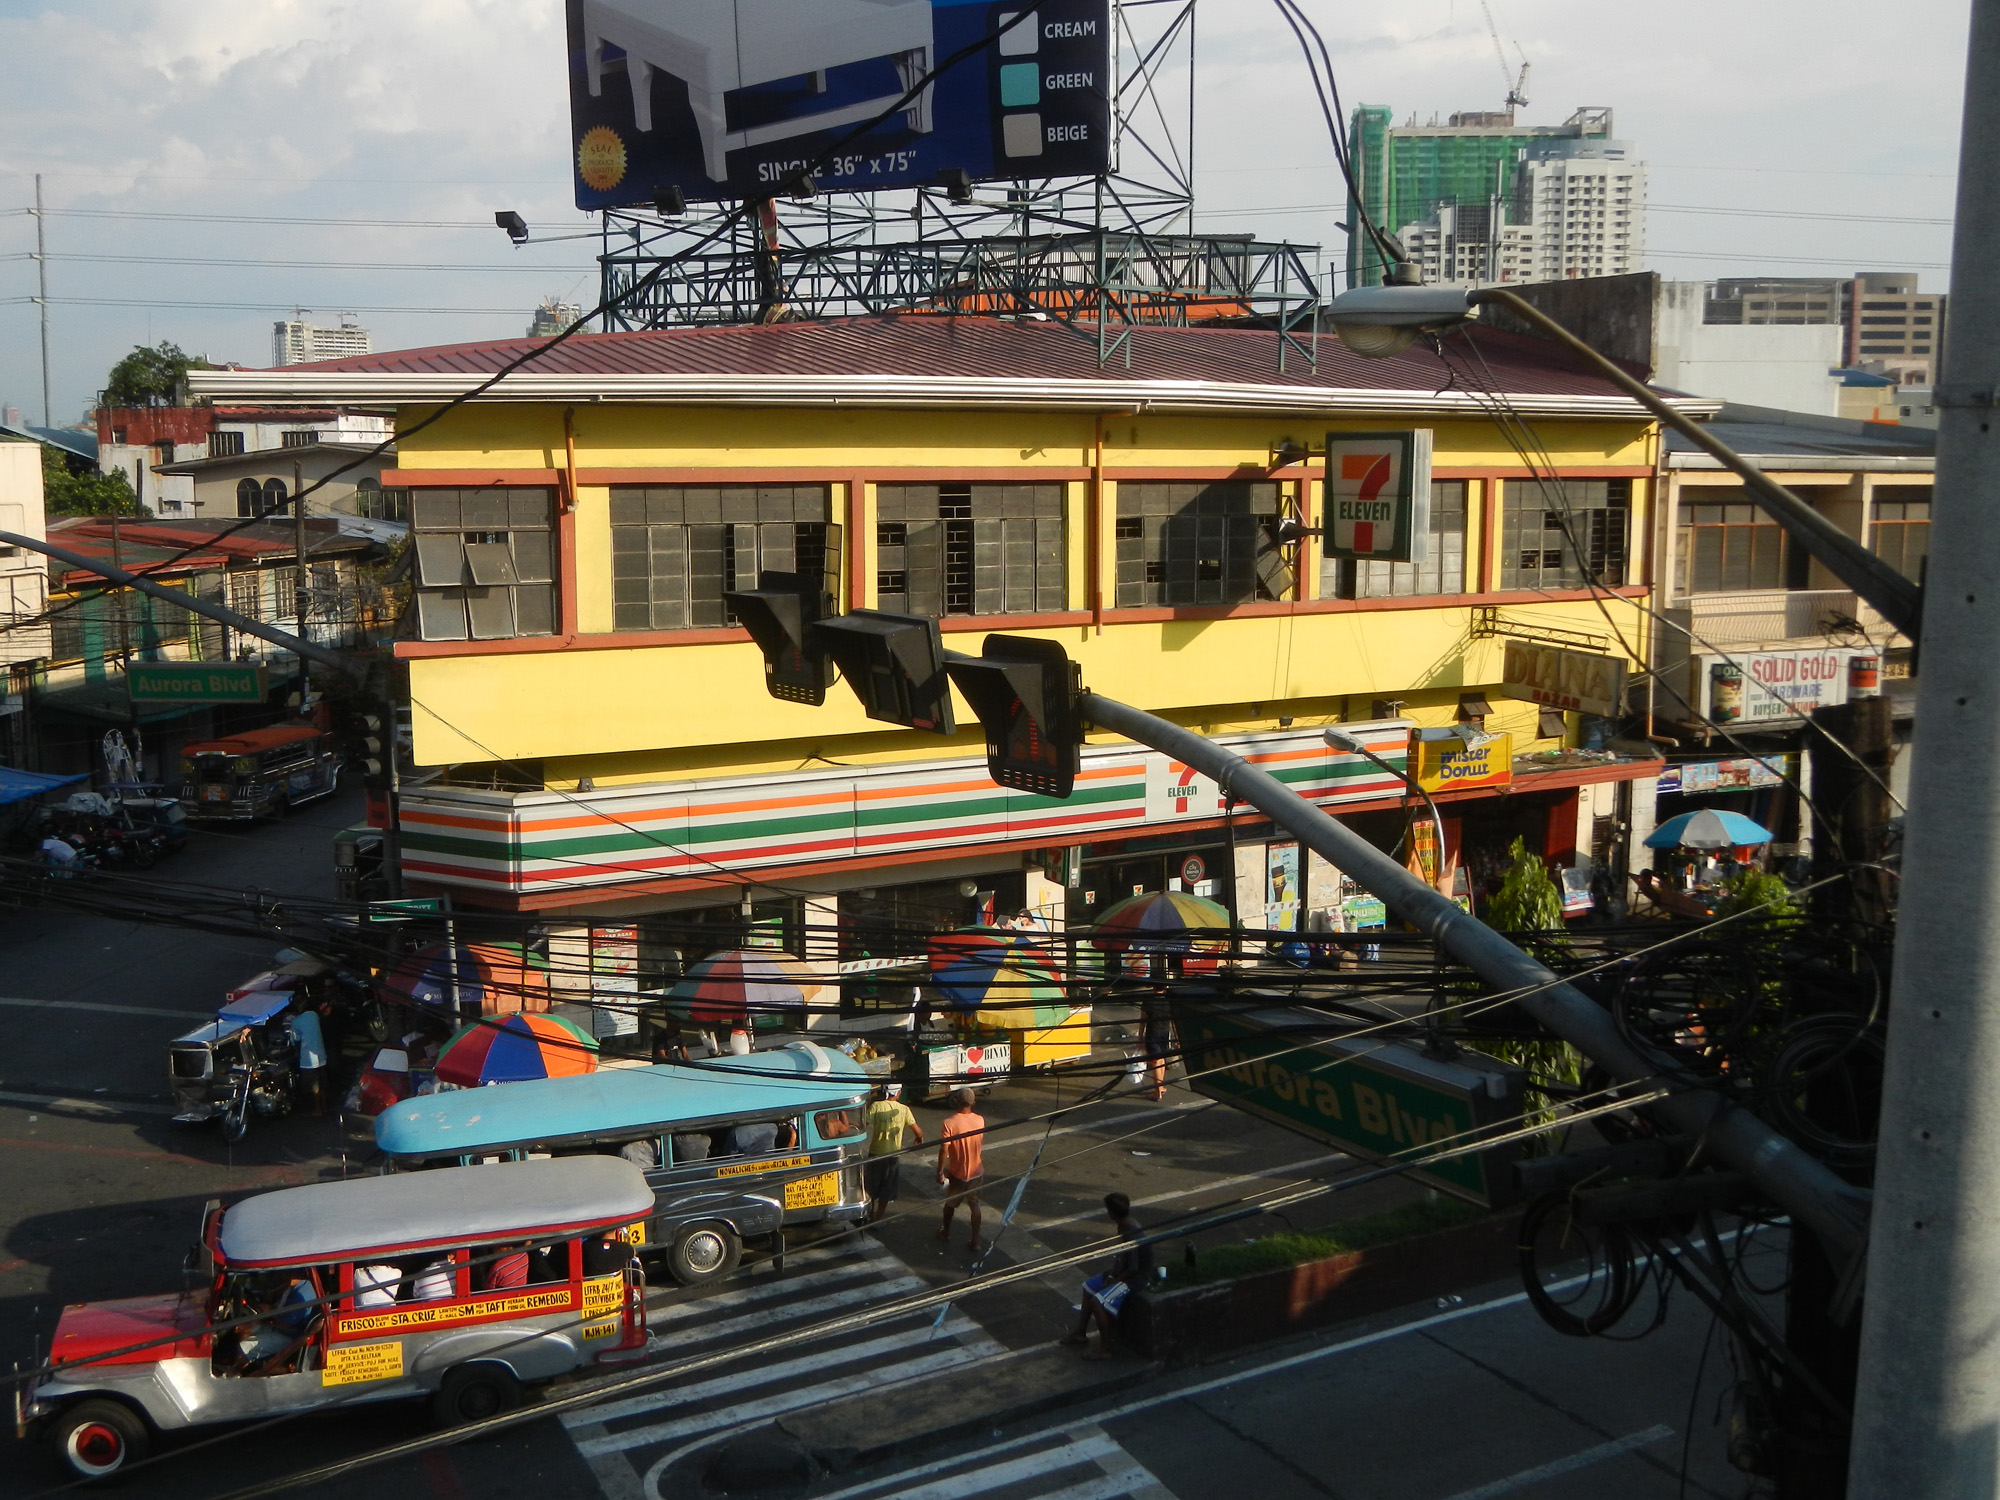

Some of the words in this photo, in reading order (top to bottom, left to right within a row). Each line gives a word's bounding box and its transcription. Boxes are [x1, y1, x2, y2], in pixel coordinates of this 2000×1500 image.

[1044, 21, 1096, 38] CREAM
[1045, 73, 1093, 90] GREEN
[1047, 125, 1088, 142] BEIGE
[590, 144, 612, 155] SEAL
[869, 159, 882, 174] x
[1504, 646, 1612, 702] DIANA
[1752, 658, 1796, 683] SOLID
[1800, 656, 1839, 681] GOLD
[138, 676, 203, 692] Aurora
[208, 676, 252, 692] Blvd
[1764, 683, 1823, 700] HARDWARE
[1440, 763, 1490, 779] Donut
[1202, 1028, 1343, 1120] Aurora
[1353, 1081, 1463, 1166] Blvd
[341, 1317, 375, 1332] FRISCO
[458, 1304, 475, 1317] SM
[486, 1300, 507, 1313] TAFT
[527, 1292, 570, 1308] REMEDIOS
